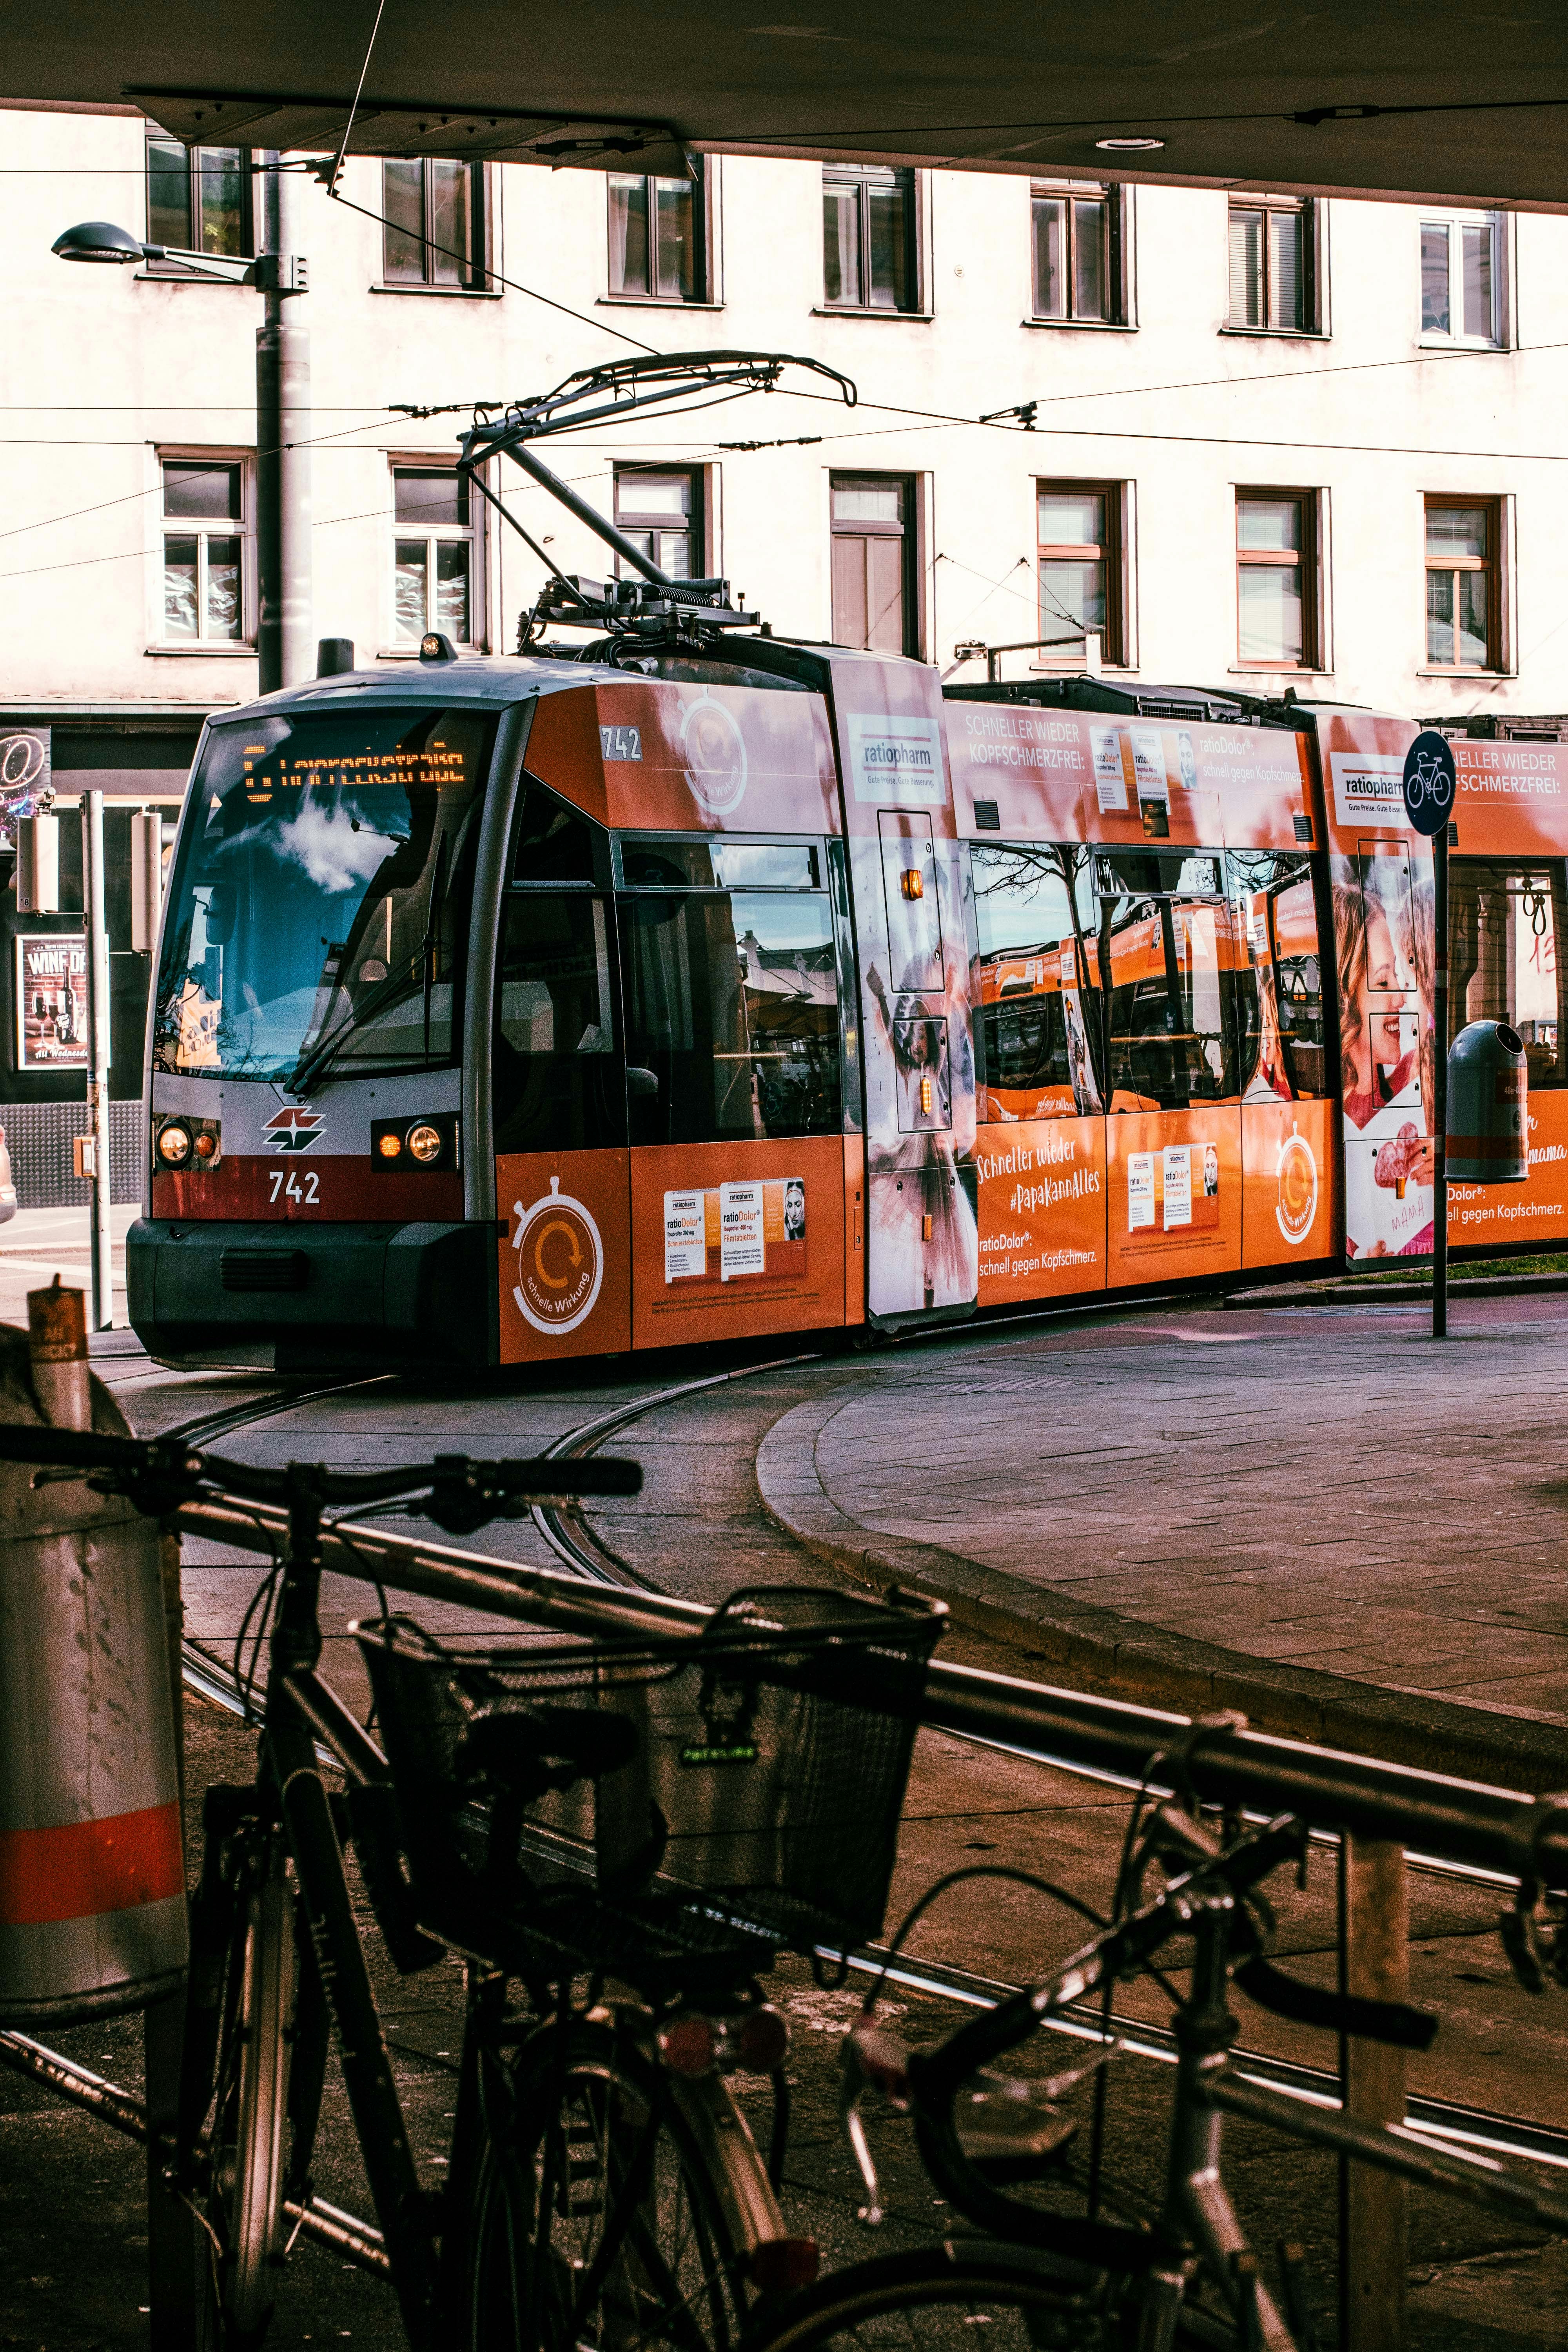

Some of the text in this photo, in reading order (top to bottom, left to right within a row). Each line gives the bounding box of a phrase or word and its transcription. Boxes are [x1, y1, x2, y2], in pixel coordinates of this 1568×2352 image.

[965, 715, 1079, 743] SCHNELLER WIEDER
[602, 727, 641, 759] 742
[865, 742, 931, 767] ratiopharm
[970, 743, 1085, 769] KOPFSCHMERZFREI:
[1454, 751, 1556, 770] NELLER WIEDER
[868, 775, 880, 784] Gute
[911, 778, 935, 788] Besserung.
[1203, 761, 1305, 784] schnell gegen Kopfschmerz.
[24, 898, 29, 907] 8
[35, 1050, 47, 1059] All
[977, 1137, 1076, 1184] Schneller wieder
[1166, 1169, 1189, 1180] ratioDolor®
[269, 1172, 320, 1204] 742
[1011, 1168, 1100, 1214] #PapaKannAlles
[667, 1216, 702, 1229] ratioDolor®
[724, 1209, 760, 1222] ratioDolor®
[1392, 1195, 1424, 1232] MAMA
[1462, 1210, 1494, 1224] gegen
[1497, 1202, 1564, 1221] Kopfschmerz.
[724, 1233, 757, 1242] Filmtabletten
[979, 1231, 1032, 1252] ratioDolor®:
[980, 1249, 1097, 1277] schnell gegen Kopfschmerz.
[527, 1272, 590, 1313] schnelle Wirkung
